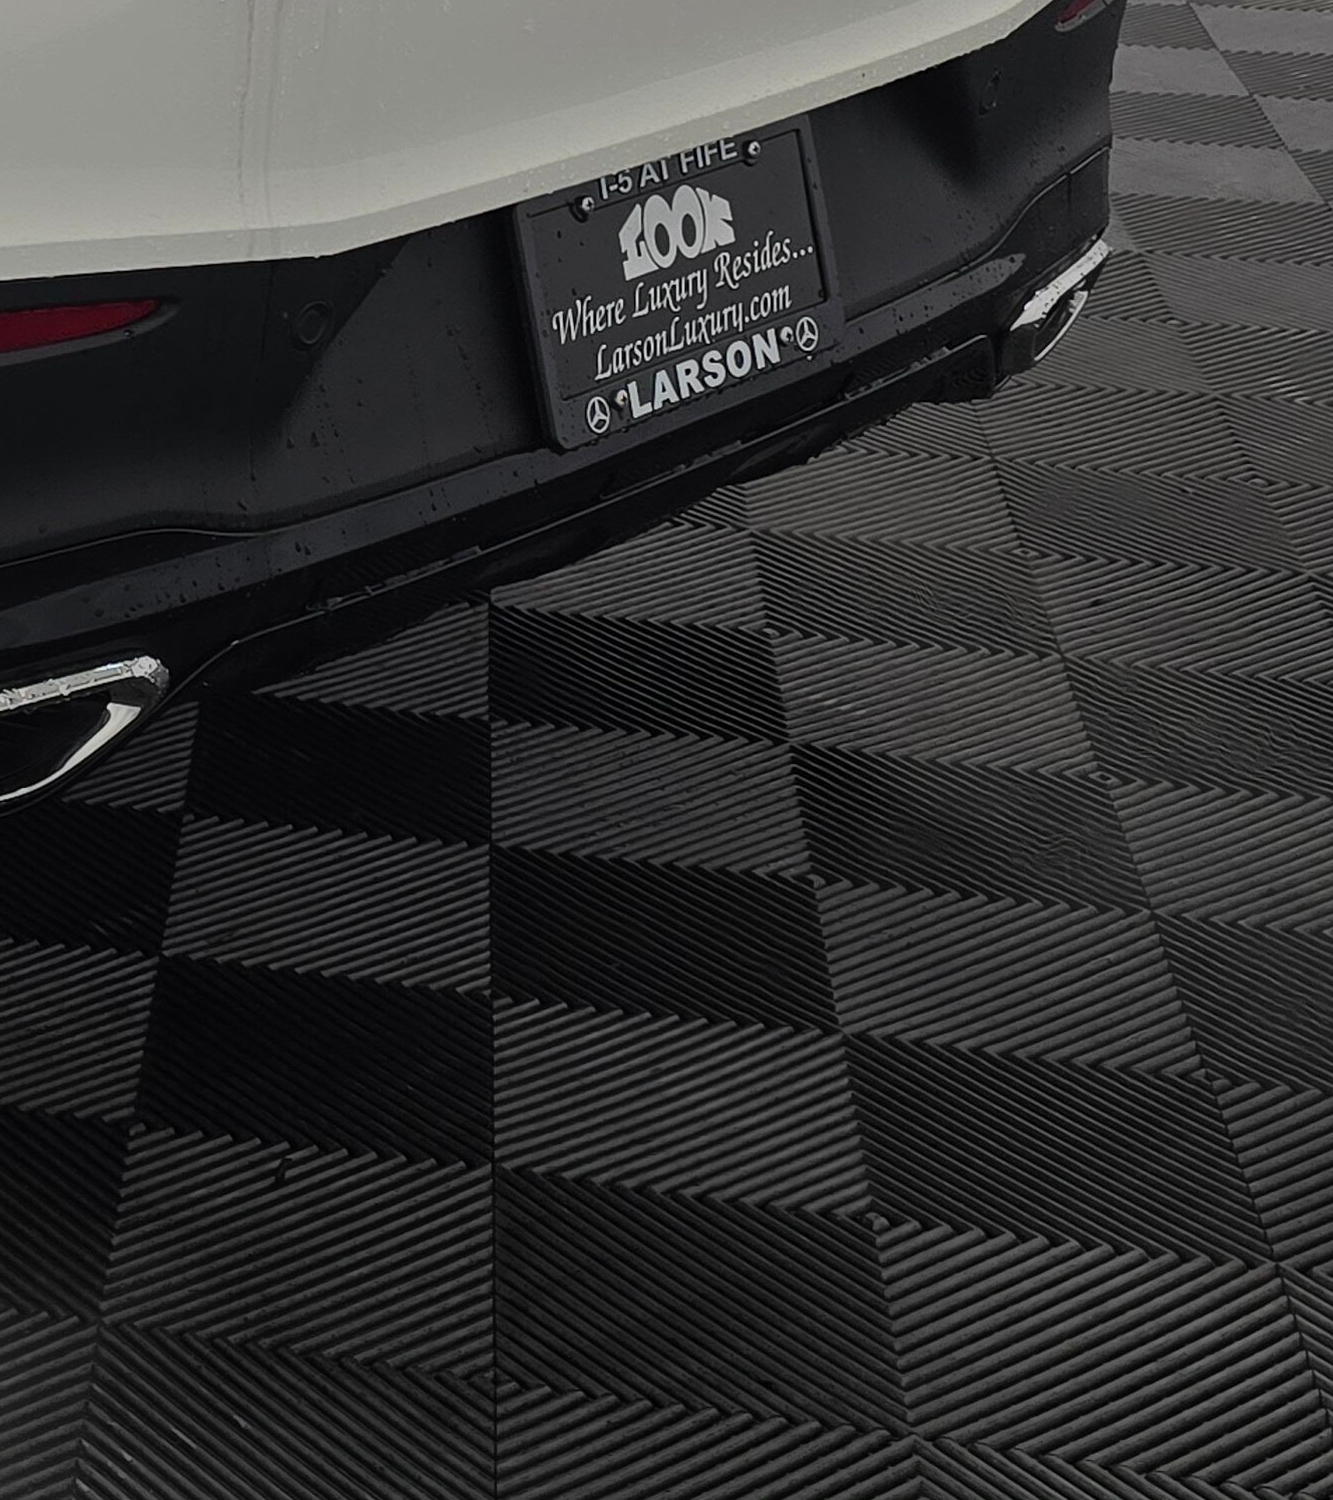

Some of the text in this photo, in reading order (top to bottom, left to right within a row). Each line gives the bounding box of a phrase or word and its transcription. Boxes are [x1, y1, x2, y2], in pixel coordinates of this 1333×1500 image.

[551, 229, 814, 345] Where Luxury Resides...
[594, 283, 792, 381] LarsonLuxury.com
[626, 328, 781, 419] LARSON
